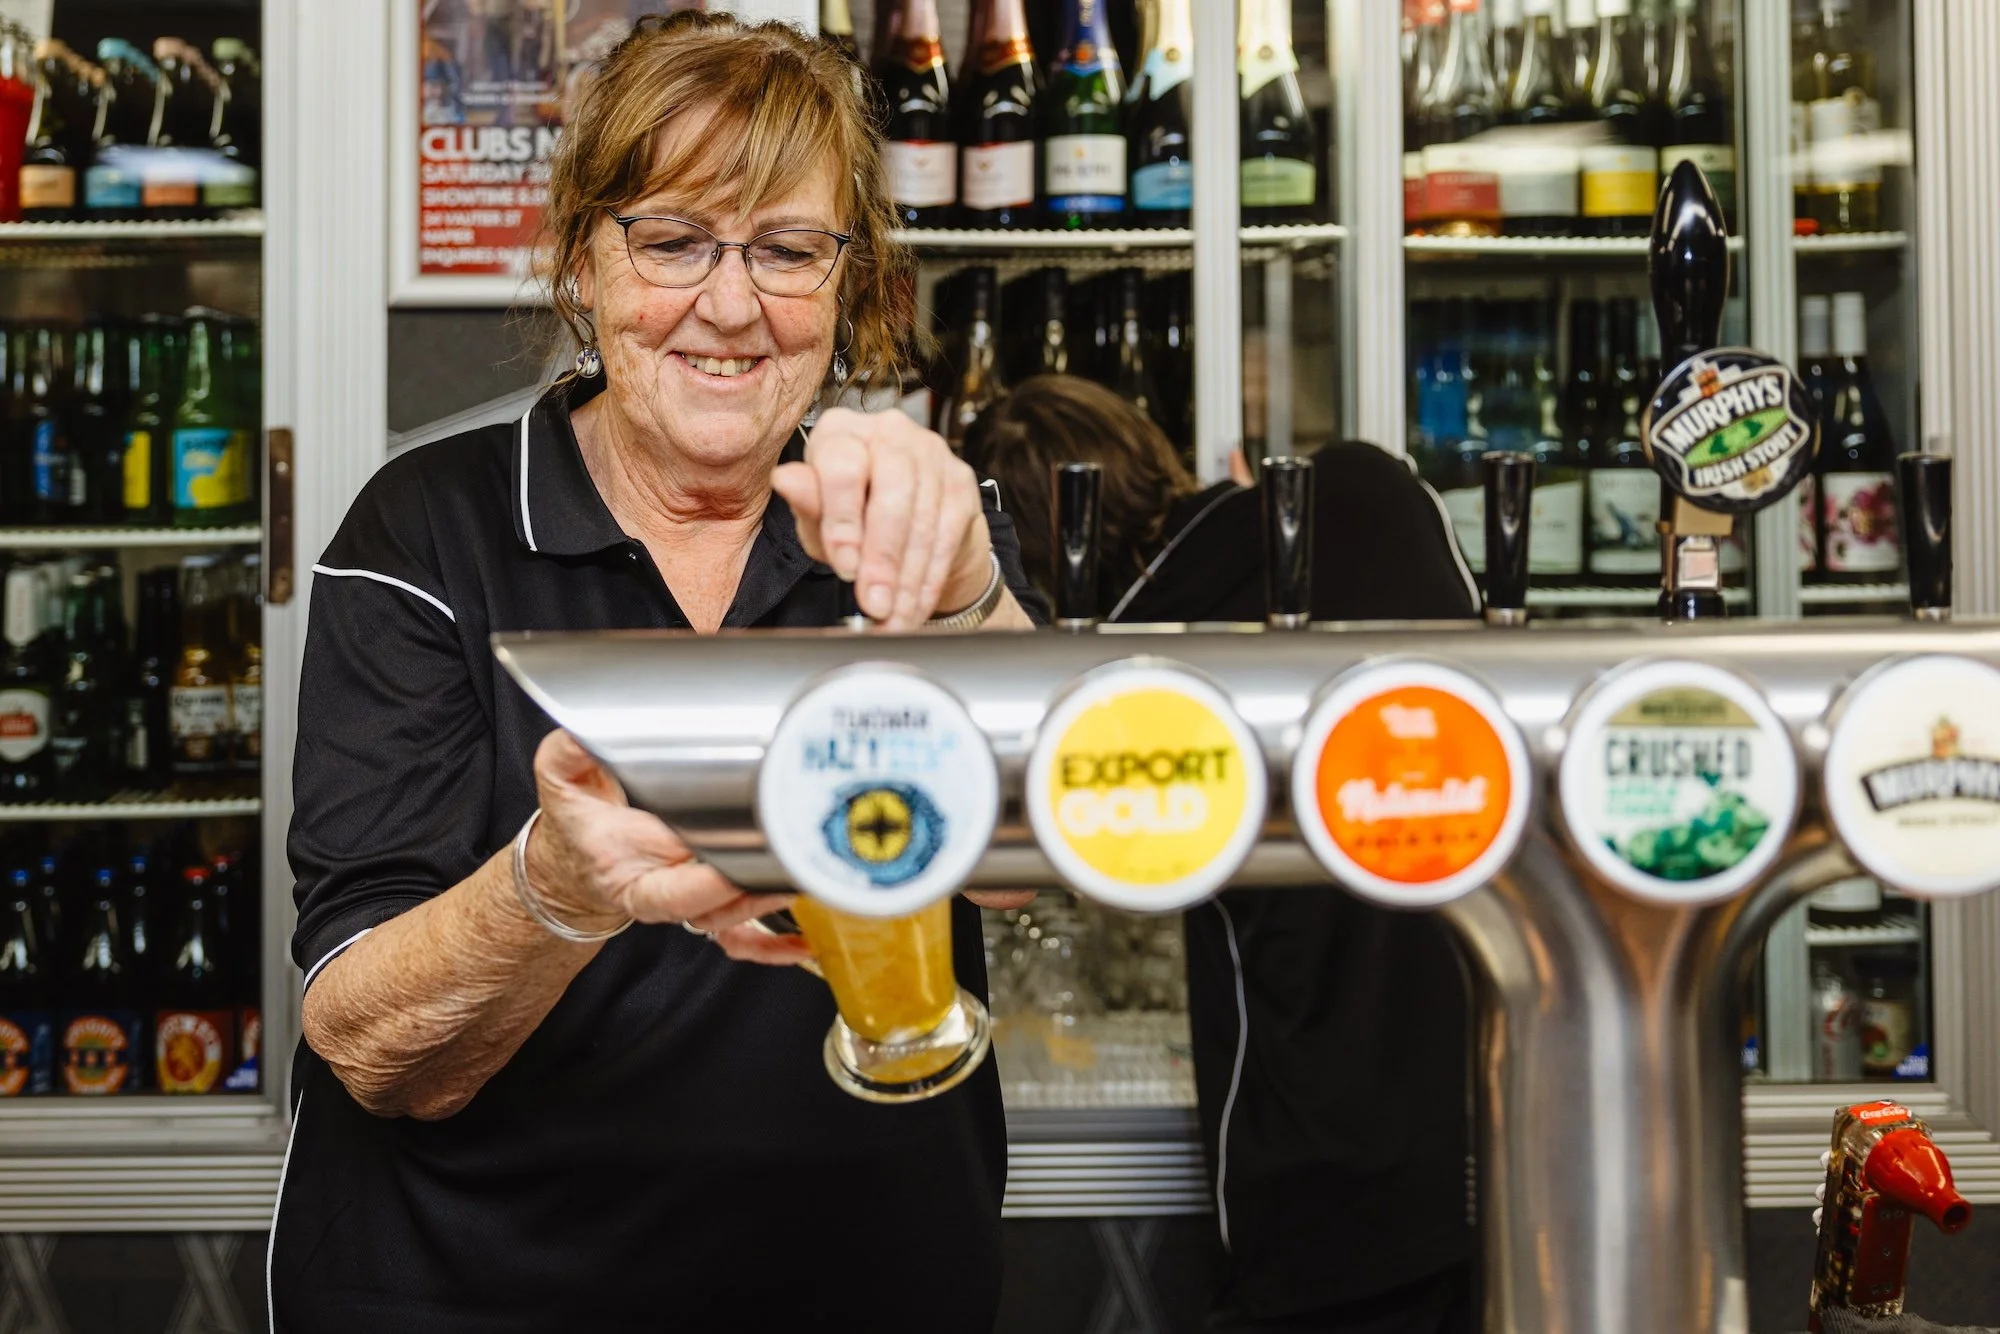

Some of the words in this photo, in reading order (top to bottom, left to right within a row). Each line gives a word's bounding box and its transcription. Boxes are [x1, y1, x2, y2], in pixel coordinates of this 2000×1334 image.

[422, 126, 532, 161] CLUBS
[422, 163, 525, 185] SATURDAY
[423, 187, 514, 207] SHOWTIME
[1743, 420, 1799, 471] STOUT
[1061, 748, 1231, 788] EXPORT
[1606, 738, 1751, 778] CRUSHED
[1058, 787, 1209, 838] GOLD
